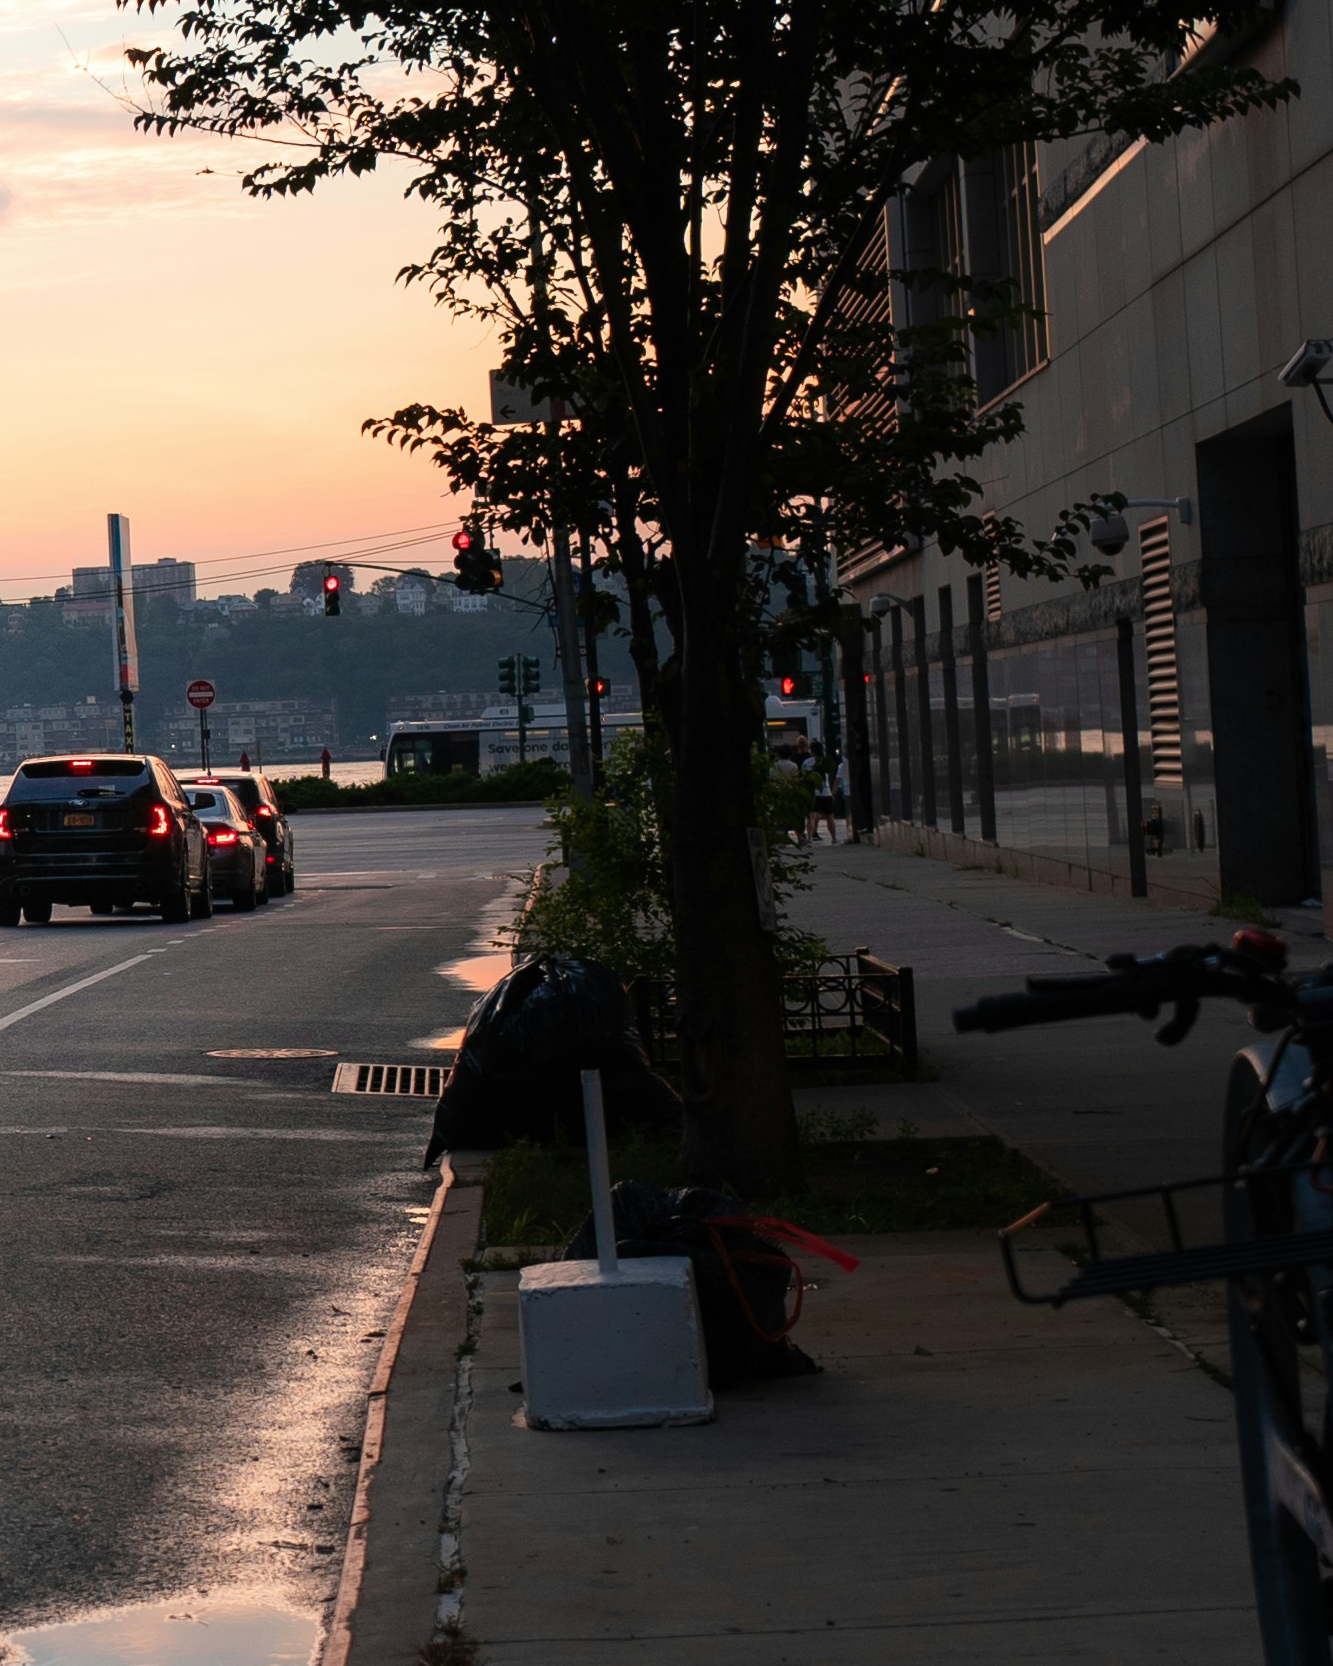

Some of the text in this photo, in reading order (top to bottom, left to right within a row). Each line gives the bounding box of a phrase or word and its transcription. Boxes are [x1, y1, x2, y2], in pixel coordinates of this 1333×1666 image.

[488, 740, 569, 754] Save one da
